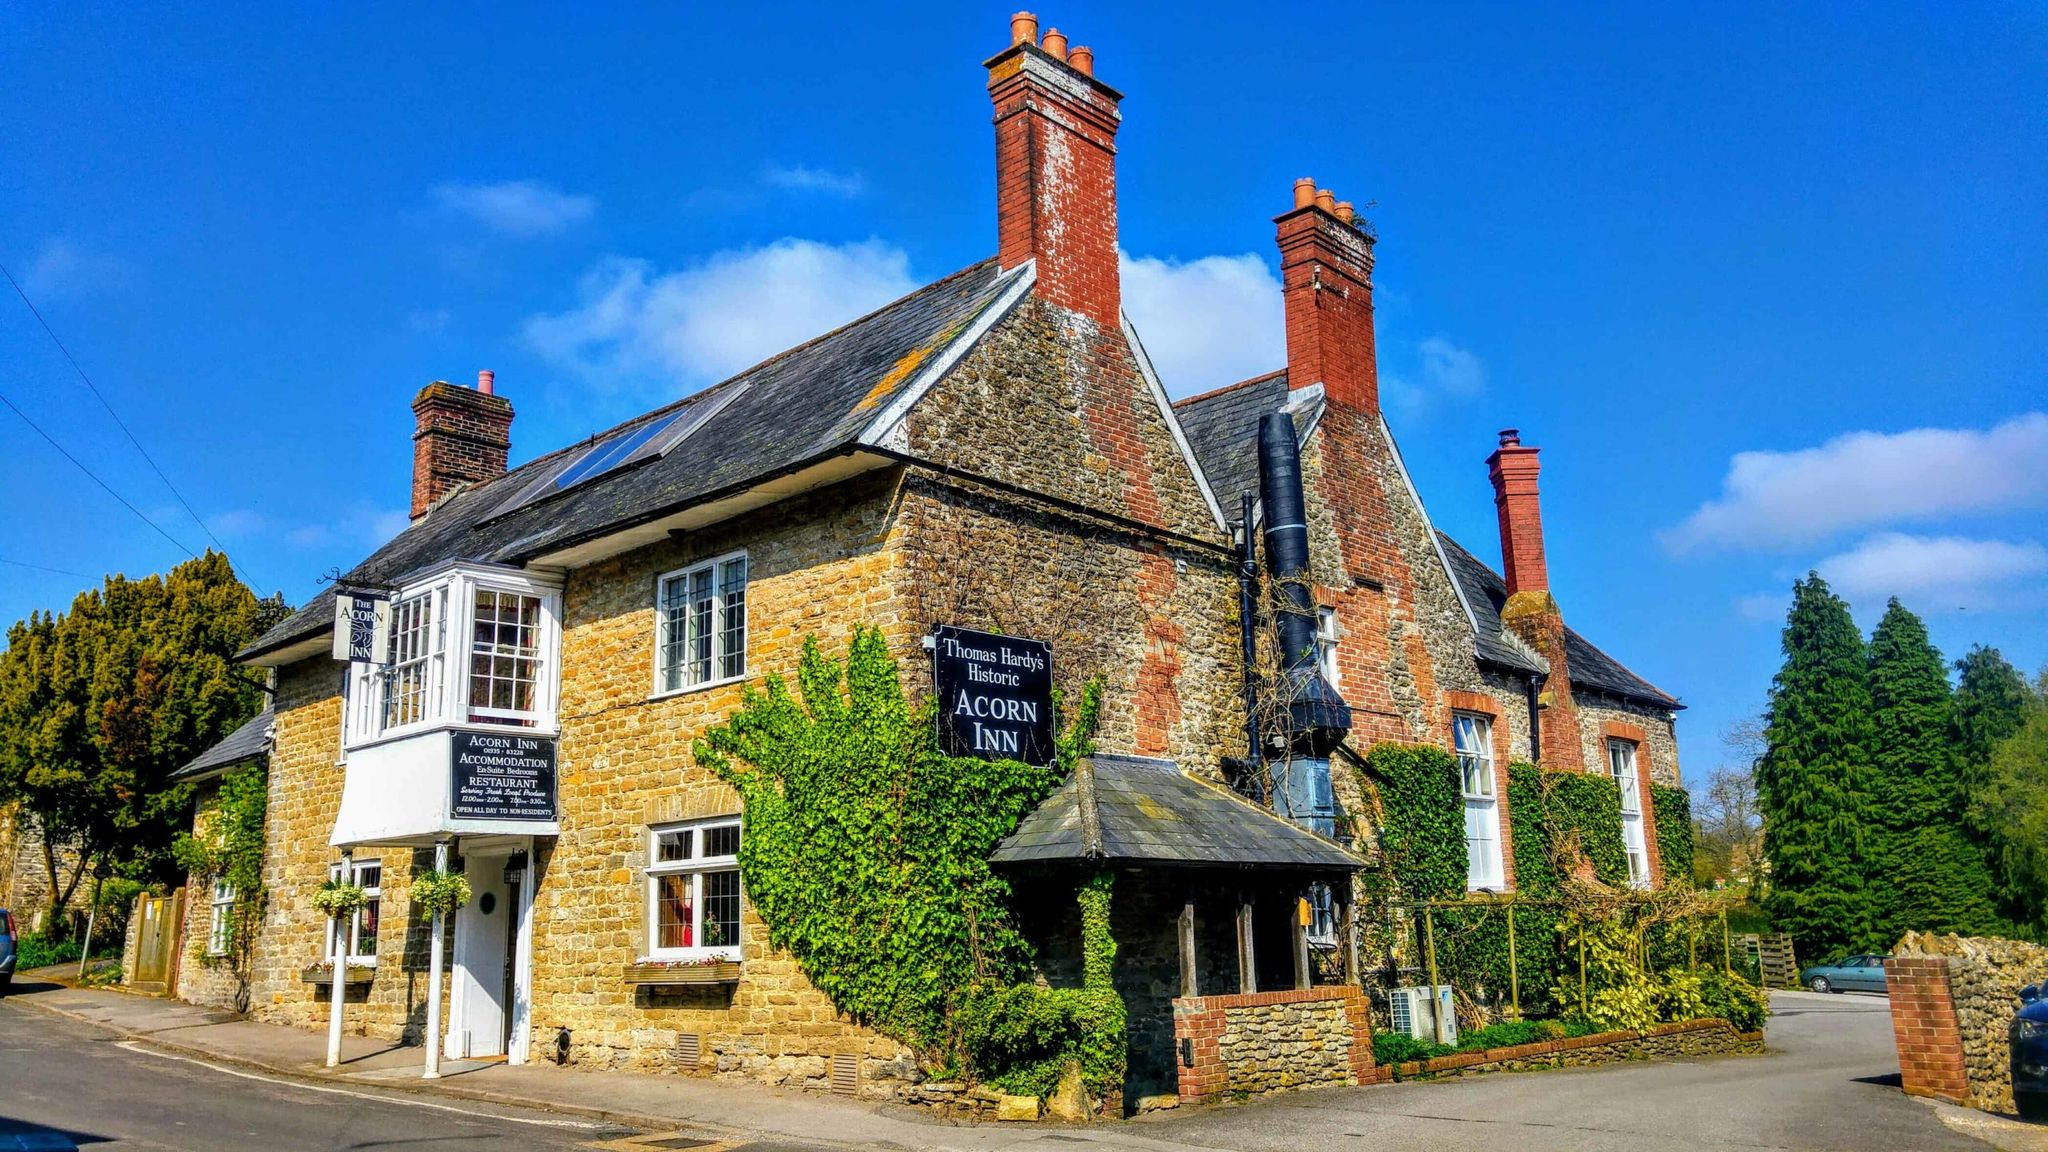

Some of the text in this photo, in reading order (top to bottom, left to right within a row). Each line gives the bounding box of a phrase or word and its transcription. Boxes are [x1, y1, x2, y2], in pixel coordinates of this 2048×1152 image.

[355, 599, 371, 608] THE
[340, 606, 383, 622] ACORN
[350, 644, 371, 658] INN
[943, 638, 1044, 672] Thomas Hardy's
[968, 663, 1020, 686] Historic
[954, 689, 1037, 722] ACORN
[469, 735, 538, 750] ACORN INN
[973, 722, 1018, 752] INN
[459, 752, 547, 768] ACCOMMODATION
[507, 767, 538, 776] Bedrooms
[469, 776, 538, 788] RESTAURANT
[460, 786, 484, 796] Serving
[523, 788, 546, 796] Produce
